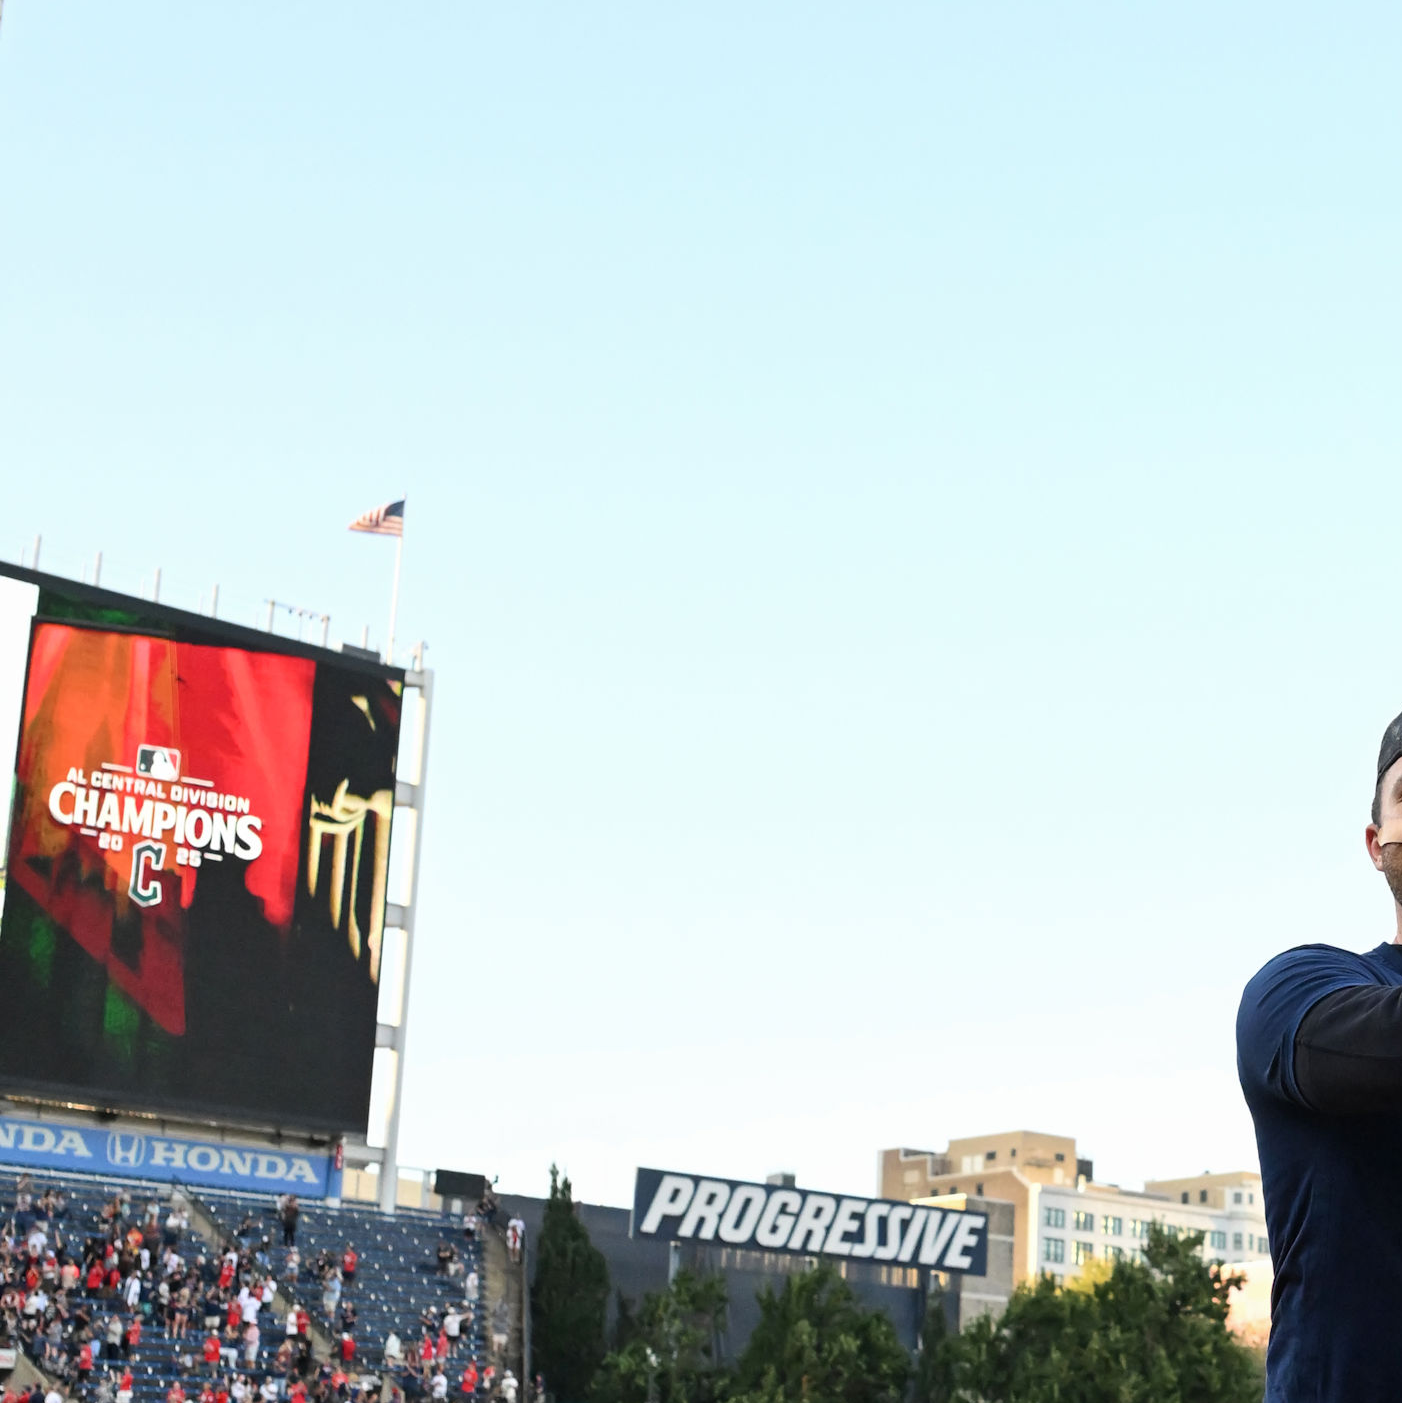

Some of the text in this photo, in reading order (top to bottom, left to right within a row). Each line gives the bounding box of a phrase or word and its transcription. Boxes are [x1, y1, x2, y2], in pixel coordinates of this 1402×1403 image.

[66, 766, 250, 815] AL CENTRAL DIVISION
[48, 781, 263, 861] CHAMPIONS
[98, 832, 123, 852] 20
[150, 1140, 320, 1185] HONDA
[640, 1174, 986, 1270] PROGRESSIVE
